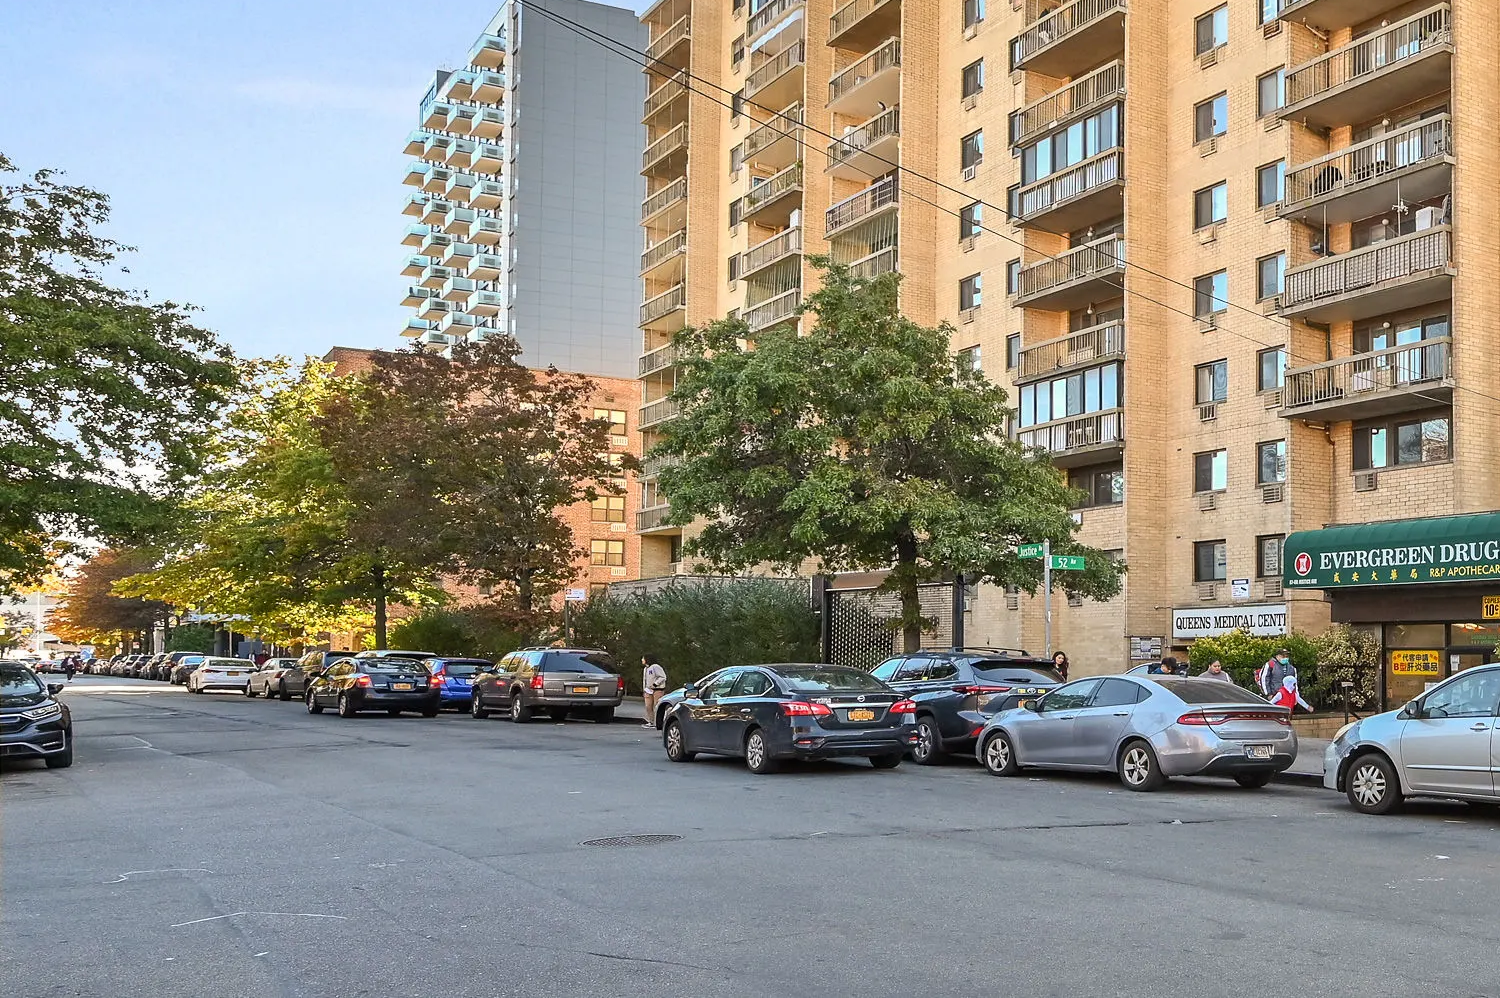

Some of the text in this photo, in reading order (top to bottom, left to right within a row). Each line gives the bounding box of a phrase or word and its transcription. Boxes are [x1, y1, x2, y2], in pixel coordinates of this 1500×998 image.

[1019, 546, 1038, 557] Justice
[1058, 557, 1068, 568] 52
[1319, 545, 1434, 571] EVERGREEN
[1429, 568, 1446, 578] R&P
[1175, 617, 1211, 630] QUEENS
[1213, 614, 1256, 629] MEDICAL
